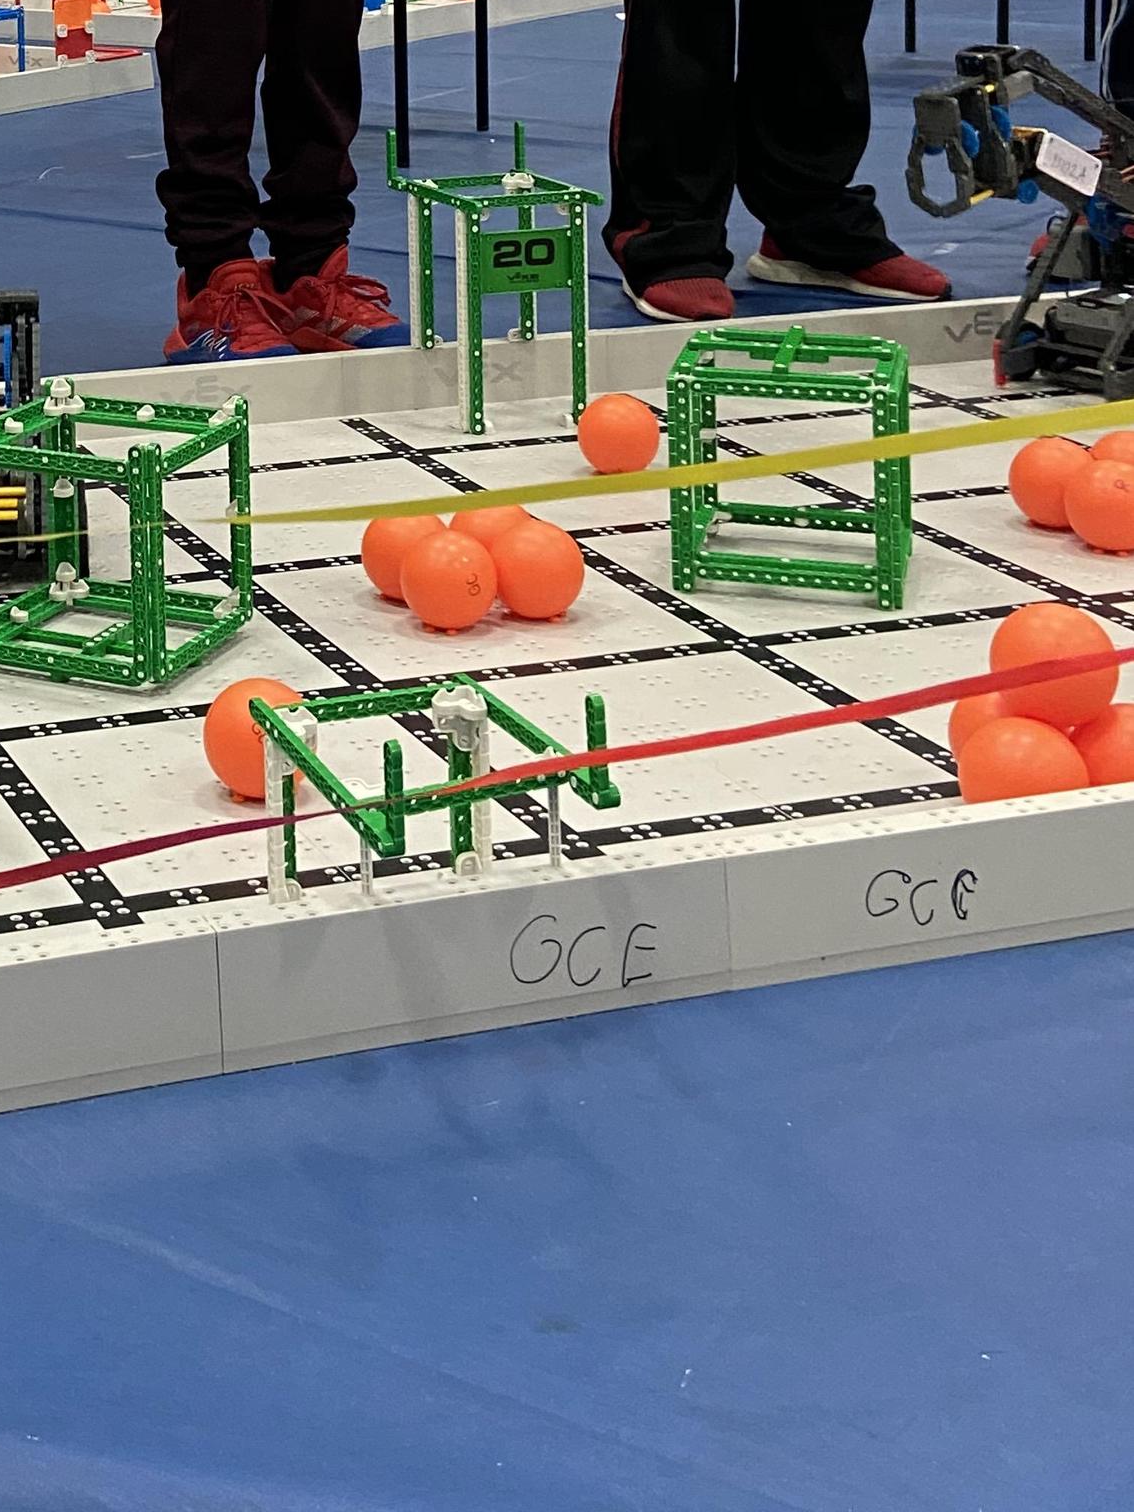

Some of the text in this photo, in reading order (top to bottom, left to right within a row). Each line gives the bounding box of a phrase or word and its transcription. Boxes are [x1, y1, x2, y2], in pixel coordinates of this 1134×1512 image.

[493, 238, 555, 268] 20
[943, 311, 1002, 343] VE
[509, 914, 657, 988] GCE
